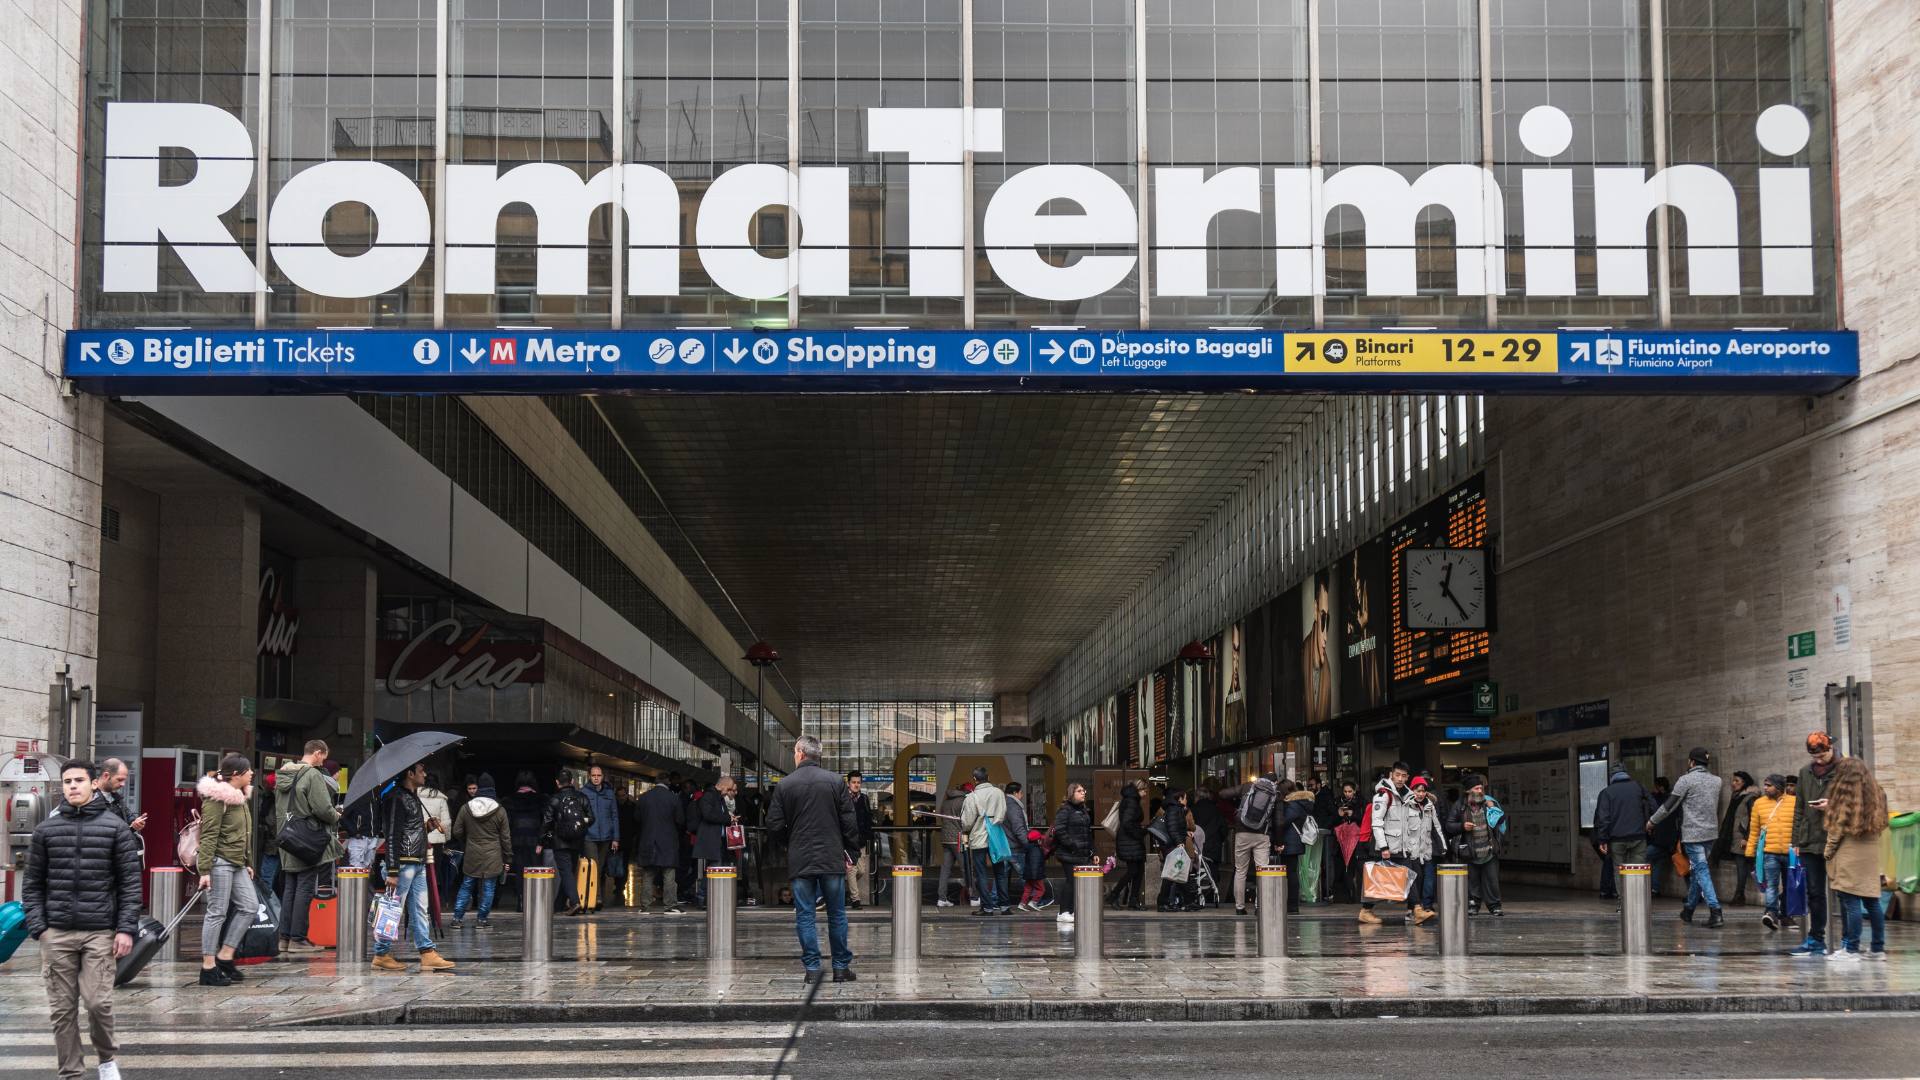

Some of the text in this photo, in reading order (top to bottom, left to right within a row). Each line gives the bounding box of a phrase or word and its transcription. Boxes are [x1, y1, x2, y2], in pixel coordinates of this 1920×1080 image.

[143, 338, 355, 369] Biglietti Tickets
[525, 339, 621, 362] Metro
[787, 337, 936, 369] Shopping
[1101, 338, 1273, 358] Deposito Bagagli
[1355, 338, 1414, 354] Binari
[1628, 339, 1830, 358] Fiumicino Aeroporto
[1102, 356, 1167, 369] Left Luggage
[1355, 356, 1401, 366] Platforms
[1629, 357, 1713, 369] Fiumicino Airport
[387, 618, 542, 696] Ciao
